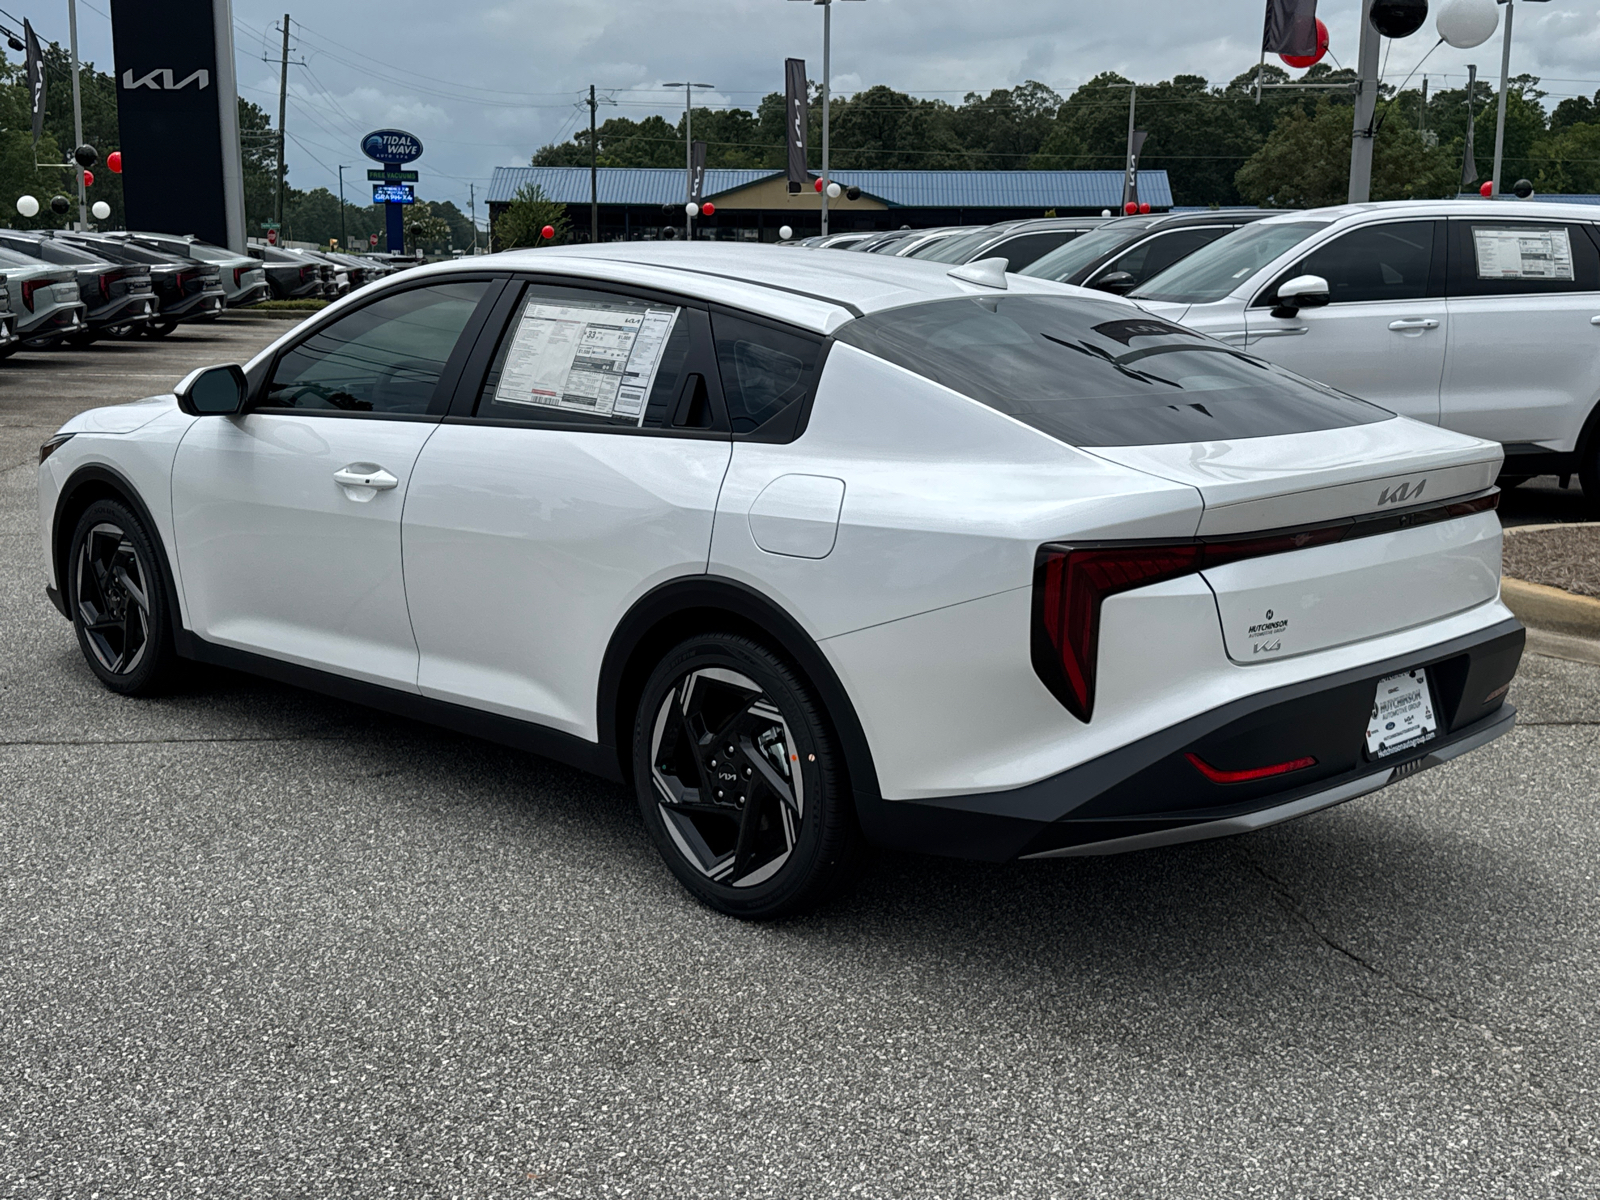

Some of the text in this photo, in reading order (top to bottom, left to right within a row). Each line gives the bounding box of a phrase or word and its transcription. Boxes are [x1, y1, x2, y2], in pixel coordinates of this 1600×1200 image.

[122, 68, 209, 91] KIA
[383, 136, 411, 145] TIDAL
[388, 145, 417, 154] WAVE
[387, 171, 415, 179] VACUUMS
[586, 330, 597, 339] 33
[1377, 478, 1427, 506] KIA
[1248, 619, 1288, 633] HUTCHINSON
